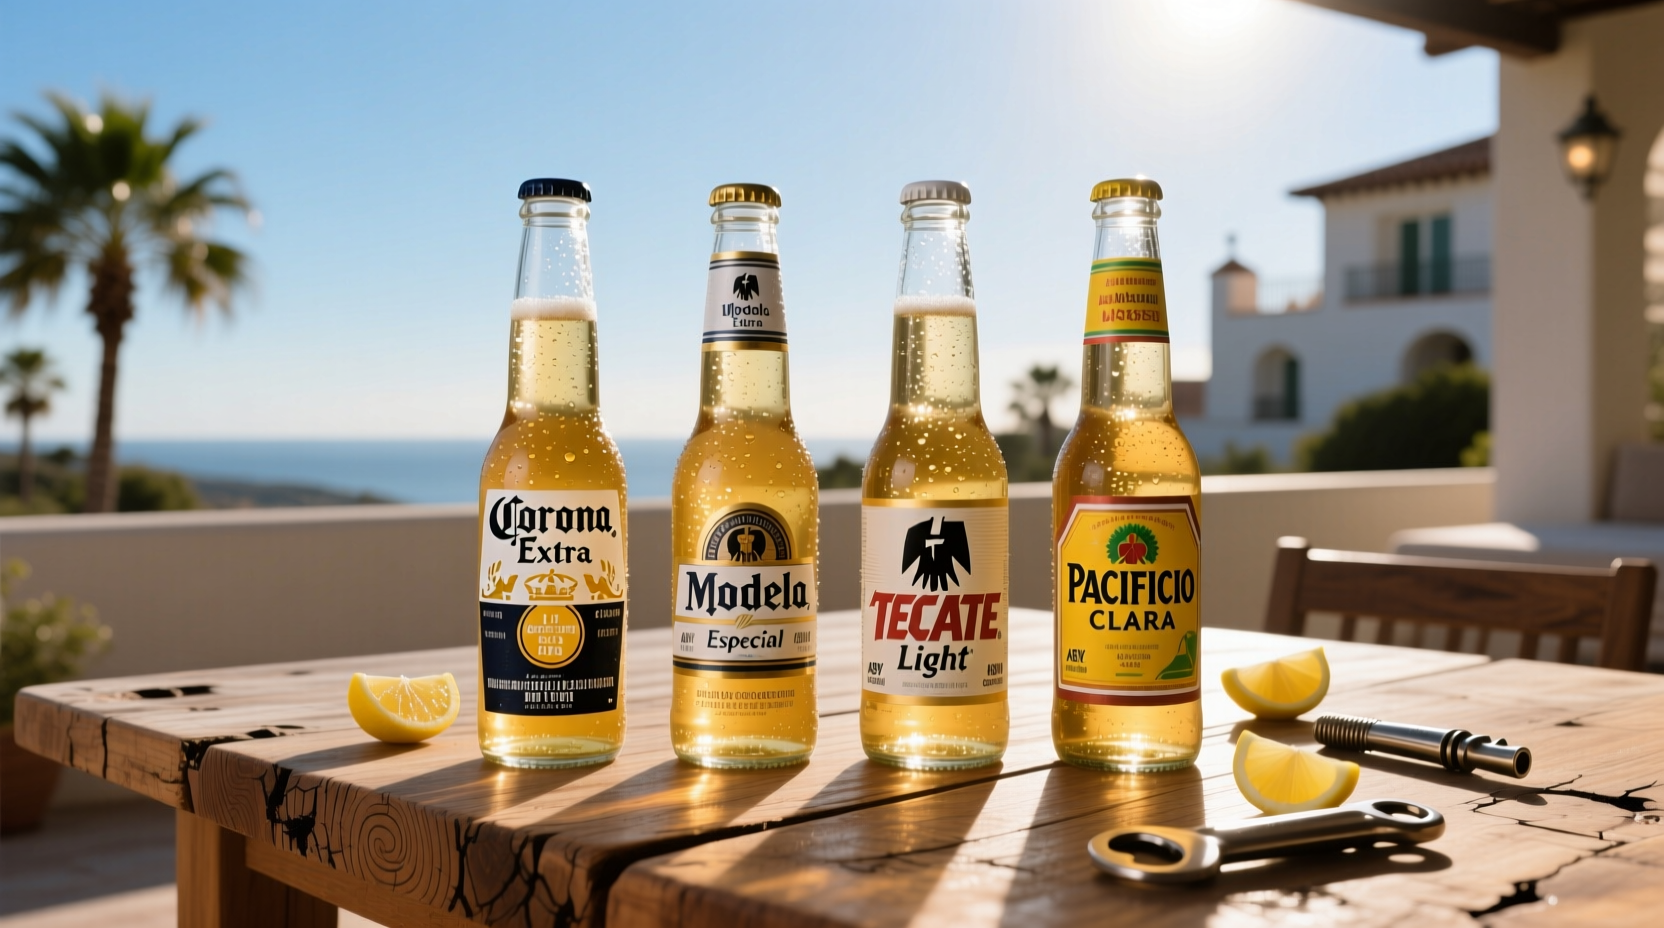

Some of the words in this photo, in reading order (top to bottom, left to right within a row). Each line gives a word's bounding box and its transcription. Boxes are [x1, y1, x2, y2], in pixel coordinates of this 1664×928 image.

[489, 495, 612, 546] Corona
[517, 536, 592, 564] Extra
[1067, 562, 1194, 605] PACIFICIO
[869, 590, 1002, 641] TECATE
[1089, 610, 1175, 631] CLARA
[707, 629, 784, 653] Especial
[897, 645, 969, 678] Light
